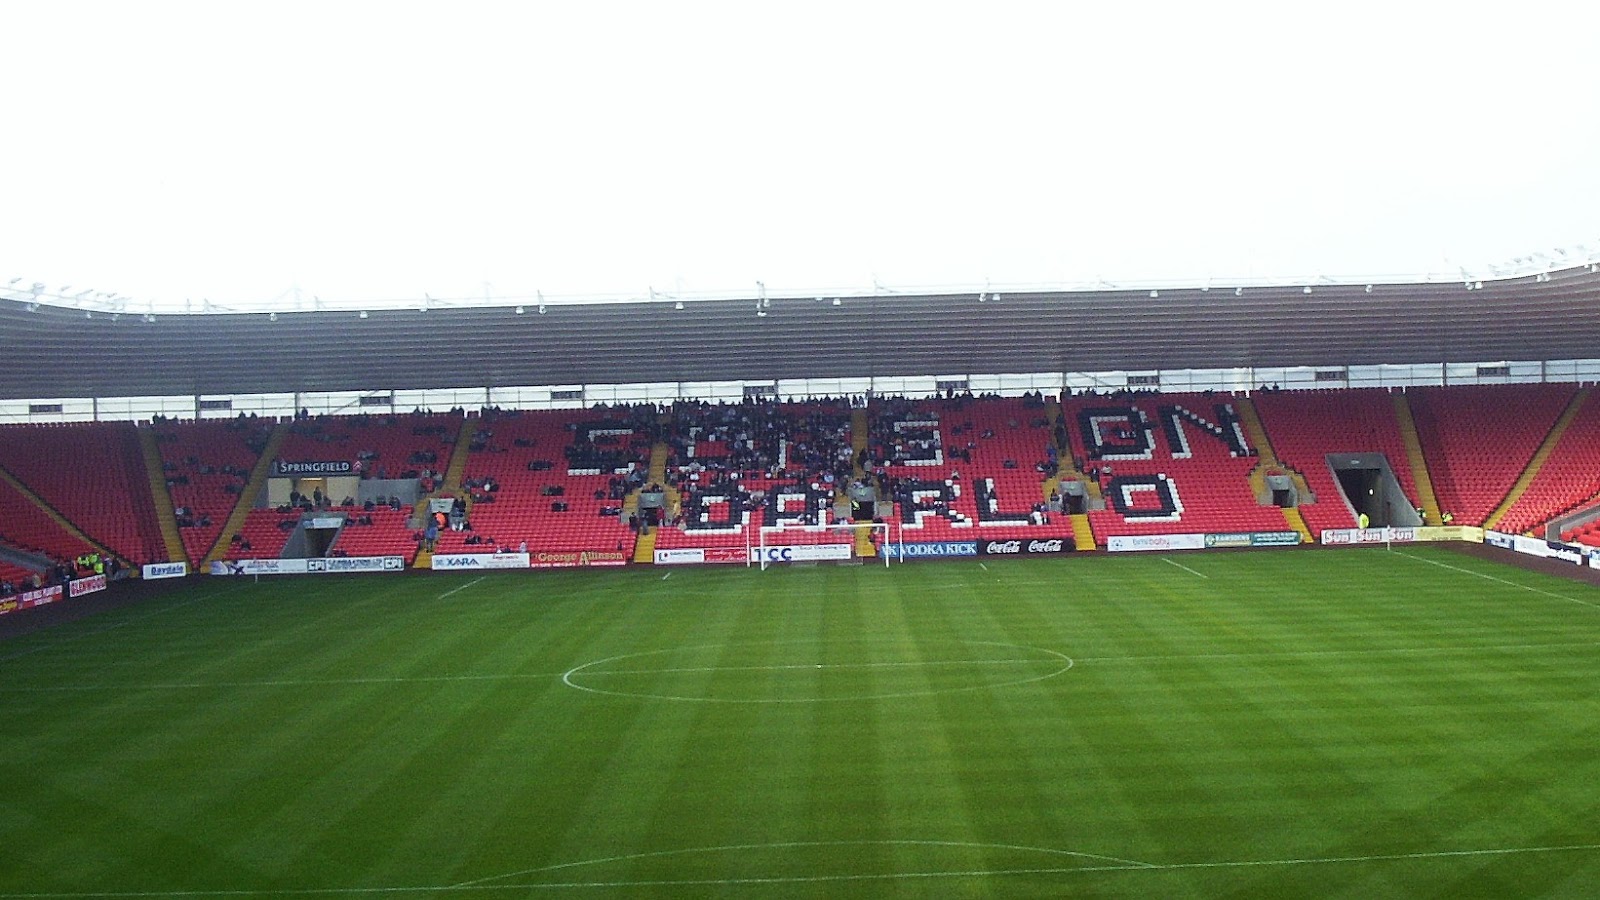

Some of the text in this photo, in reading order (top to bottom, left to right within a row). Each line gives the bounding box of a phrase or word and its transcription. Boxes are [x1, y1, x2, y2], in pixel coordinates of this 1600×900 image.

[280, 462, 350, 473] SPRINGFIELD
[1324, 530, 1350, 544] Sun
[1357, 529, 1382, 542] Sun
[1387, 527, 1413, 541] Sun
[754, 547, 792, 561] TCC
[900, 544, 944, 555] VODKA
[946, 543, 977, 554] KICK
[447, 558, 480, 566] XARA
[539, 552, 577, 563] George
